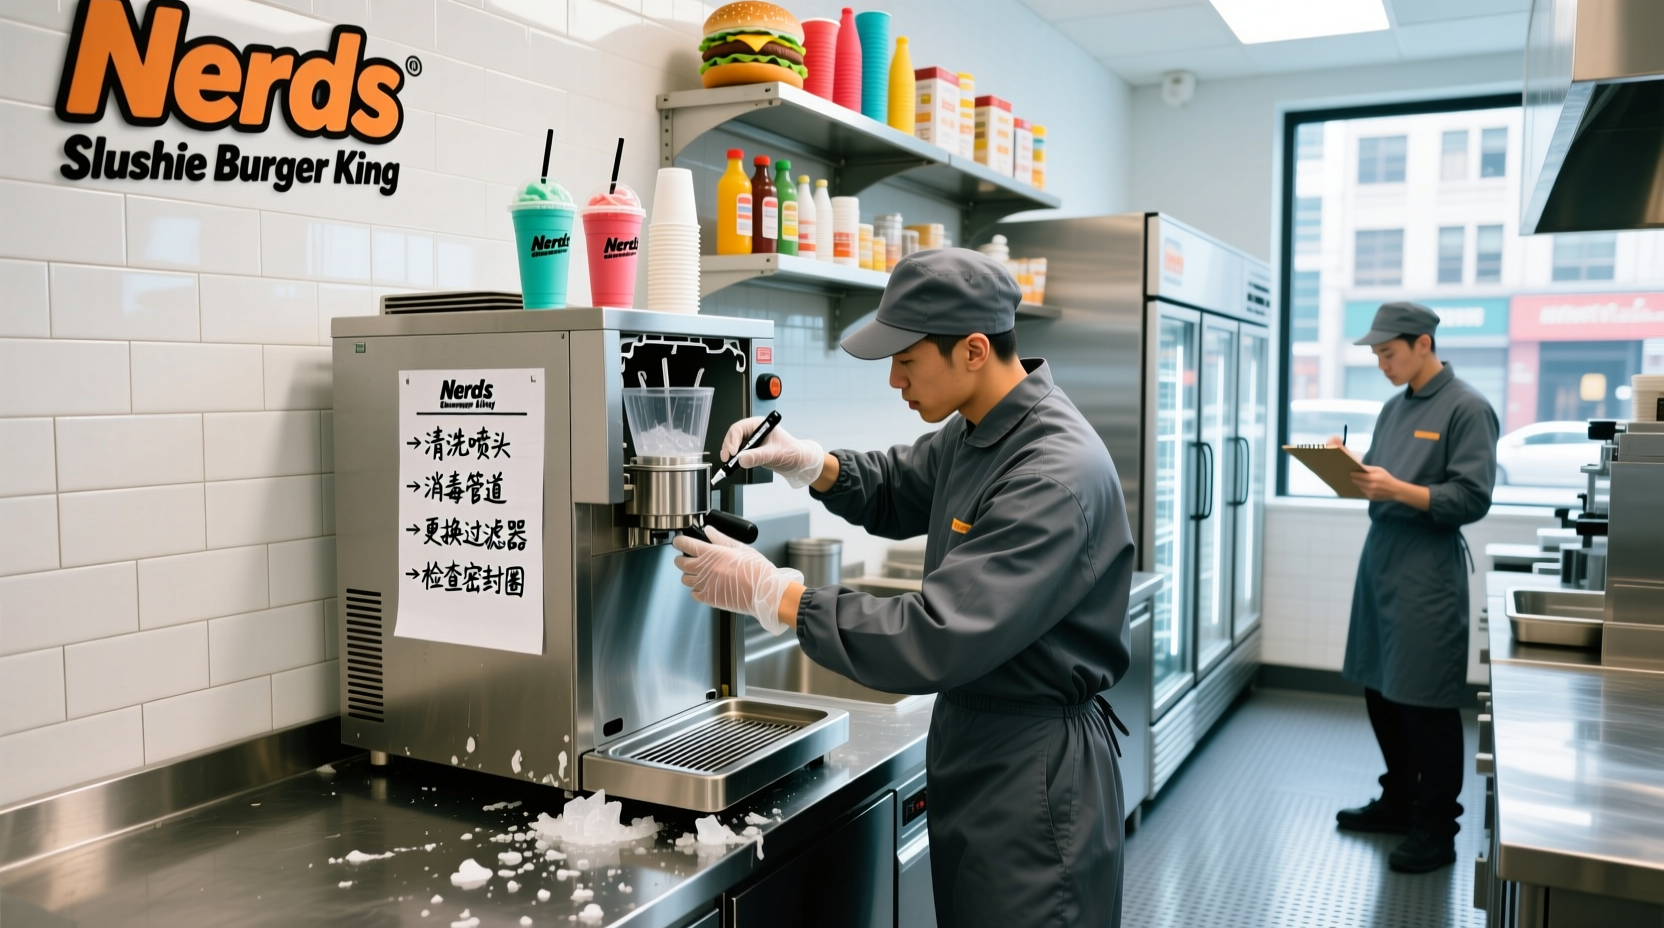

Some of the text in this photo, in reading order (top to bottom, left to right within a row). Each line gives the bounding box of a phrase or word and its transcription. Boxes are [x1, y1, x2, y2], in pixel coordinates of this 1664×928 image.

[55, 0, 405, 144] Nerds
[60, 133, 400, 196] Slushie Burger King
[440, 379, 494, 400] Nerds
[425, 426, 511, 461] 清洗喷头
[424, 471, 507, 504] 消毒管道
[423, 517, 527, 551] 更换过滤器
[421, 560, 524, 597] 检查密封圈
